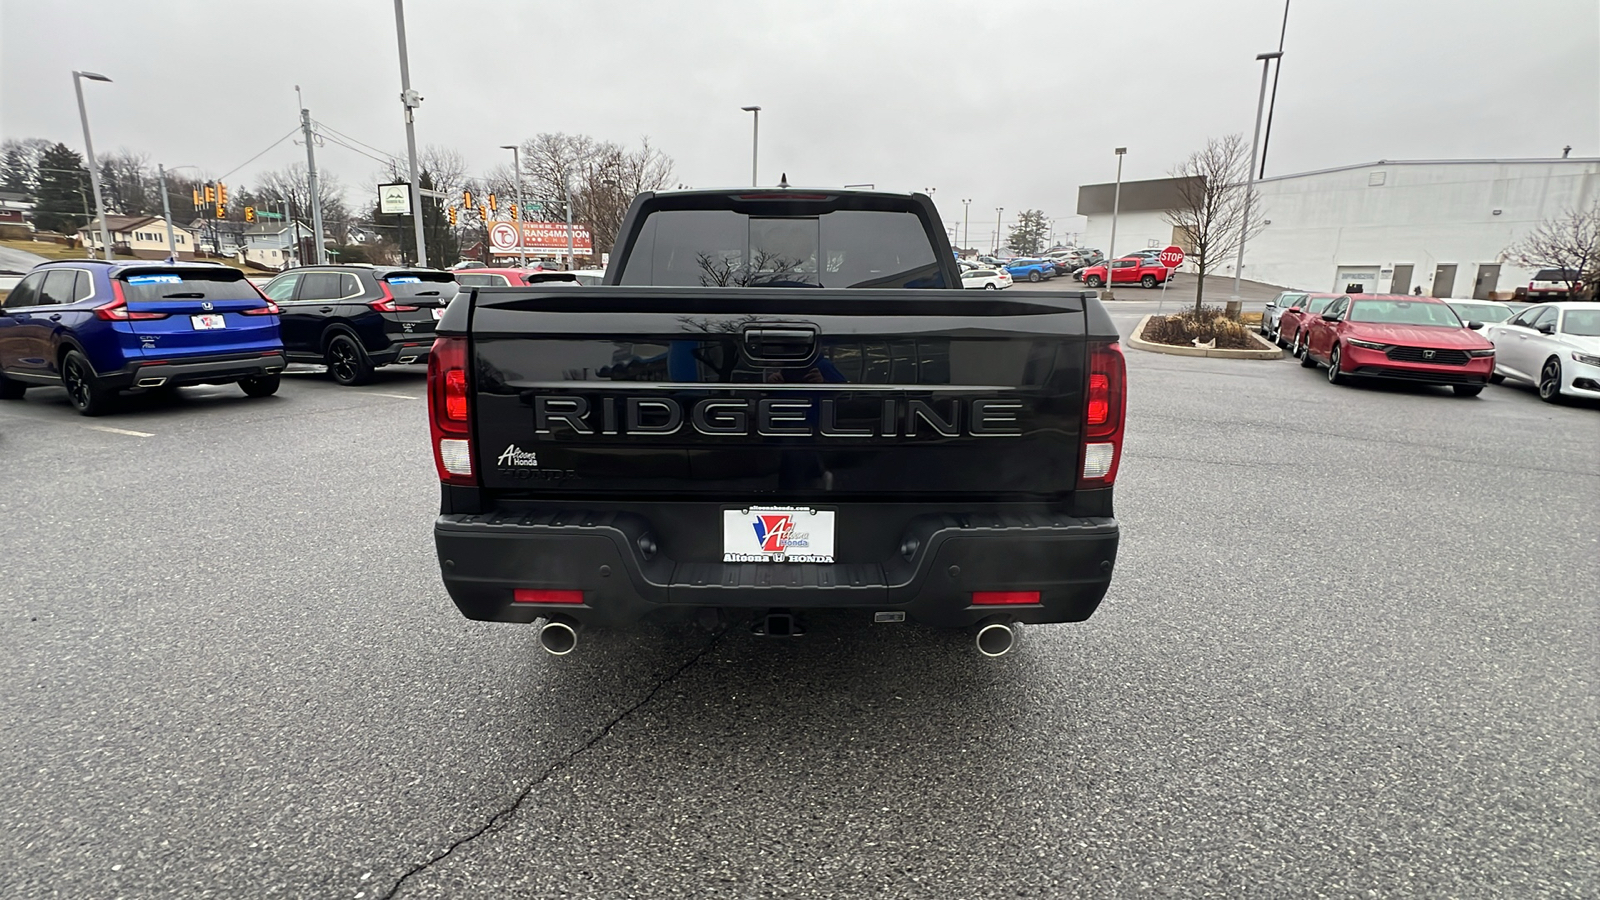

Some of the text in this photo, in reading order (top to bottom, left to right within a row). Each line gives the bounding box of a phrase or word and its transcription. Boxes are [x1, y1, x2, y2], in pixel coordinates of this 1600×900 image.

[523, 229, 590, 239] RANS4MAION
[1161, 252, 1183, 262] STOP
[535, 395, 1023, 437] RIDGELINE
[497, 444, 536, 466] Altoona
[513, 458, 538, 466] Honda
[761, 518, 810, 547] Altoona
[780, 539, 809, 547] Honda
[723, 552, 770, 562] Altoona
[788, 554, 835, 563] HONDA
